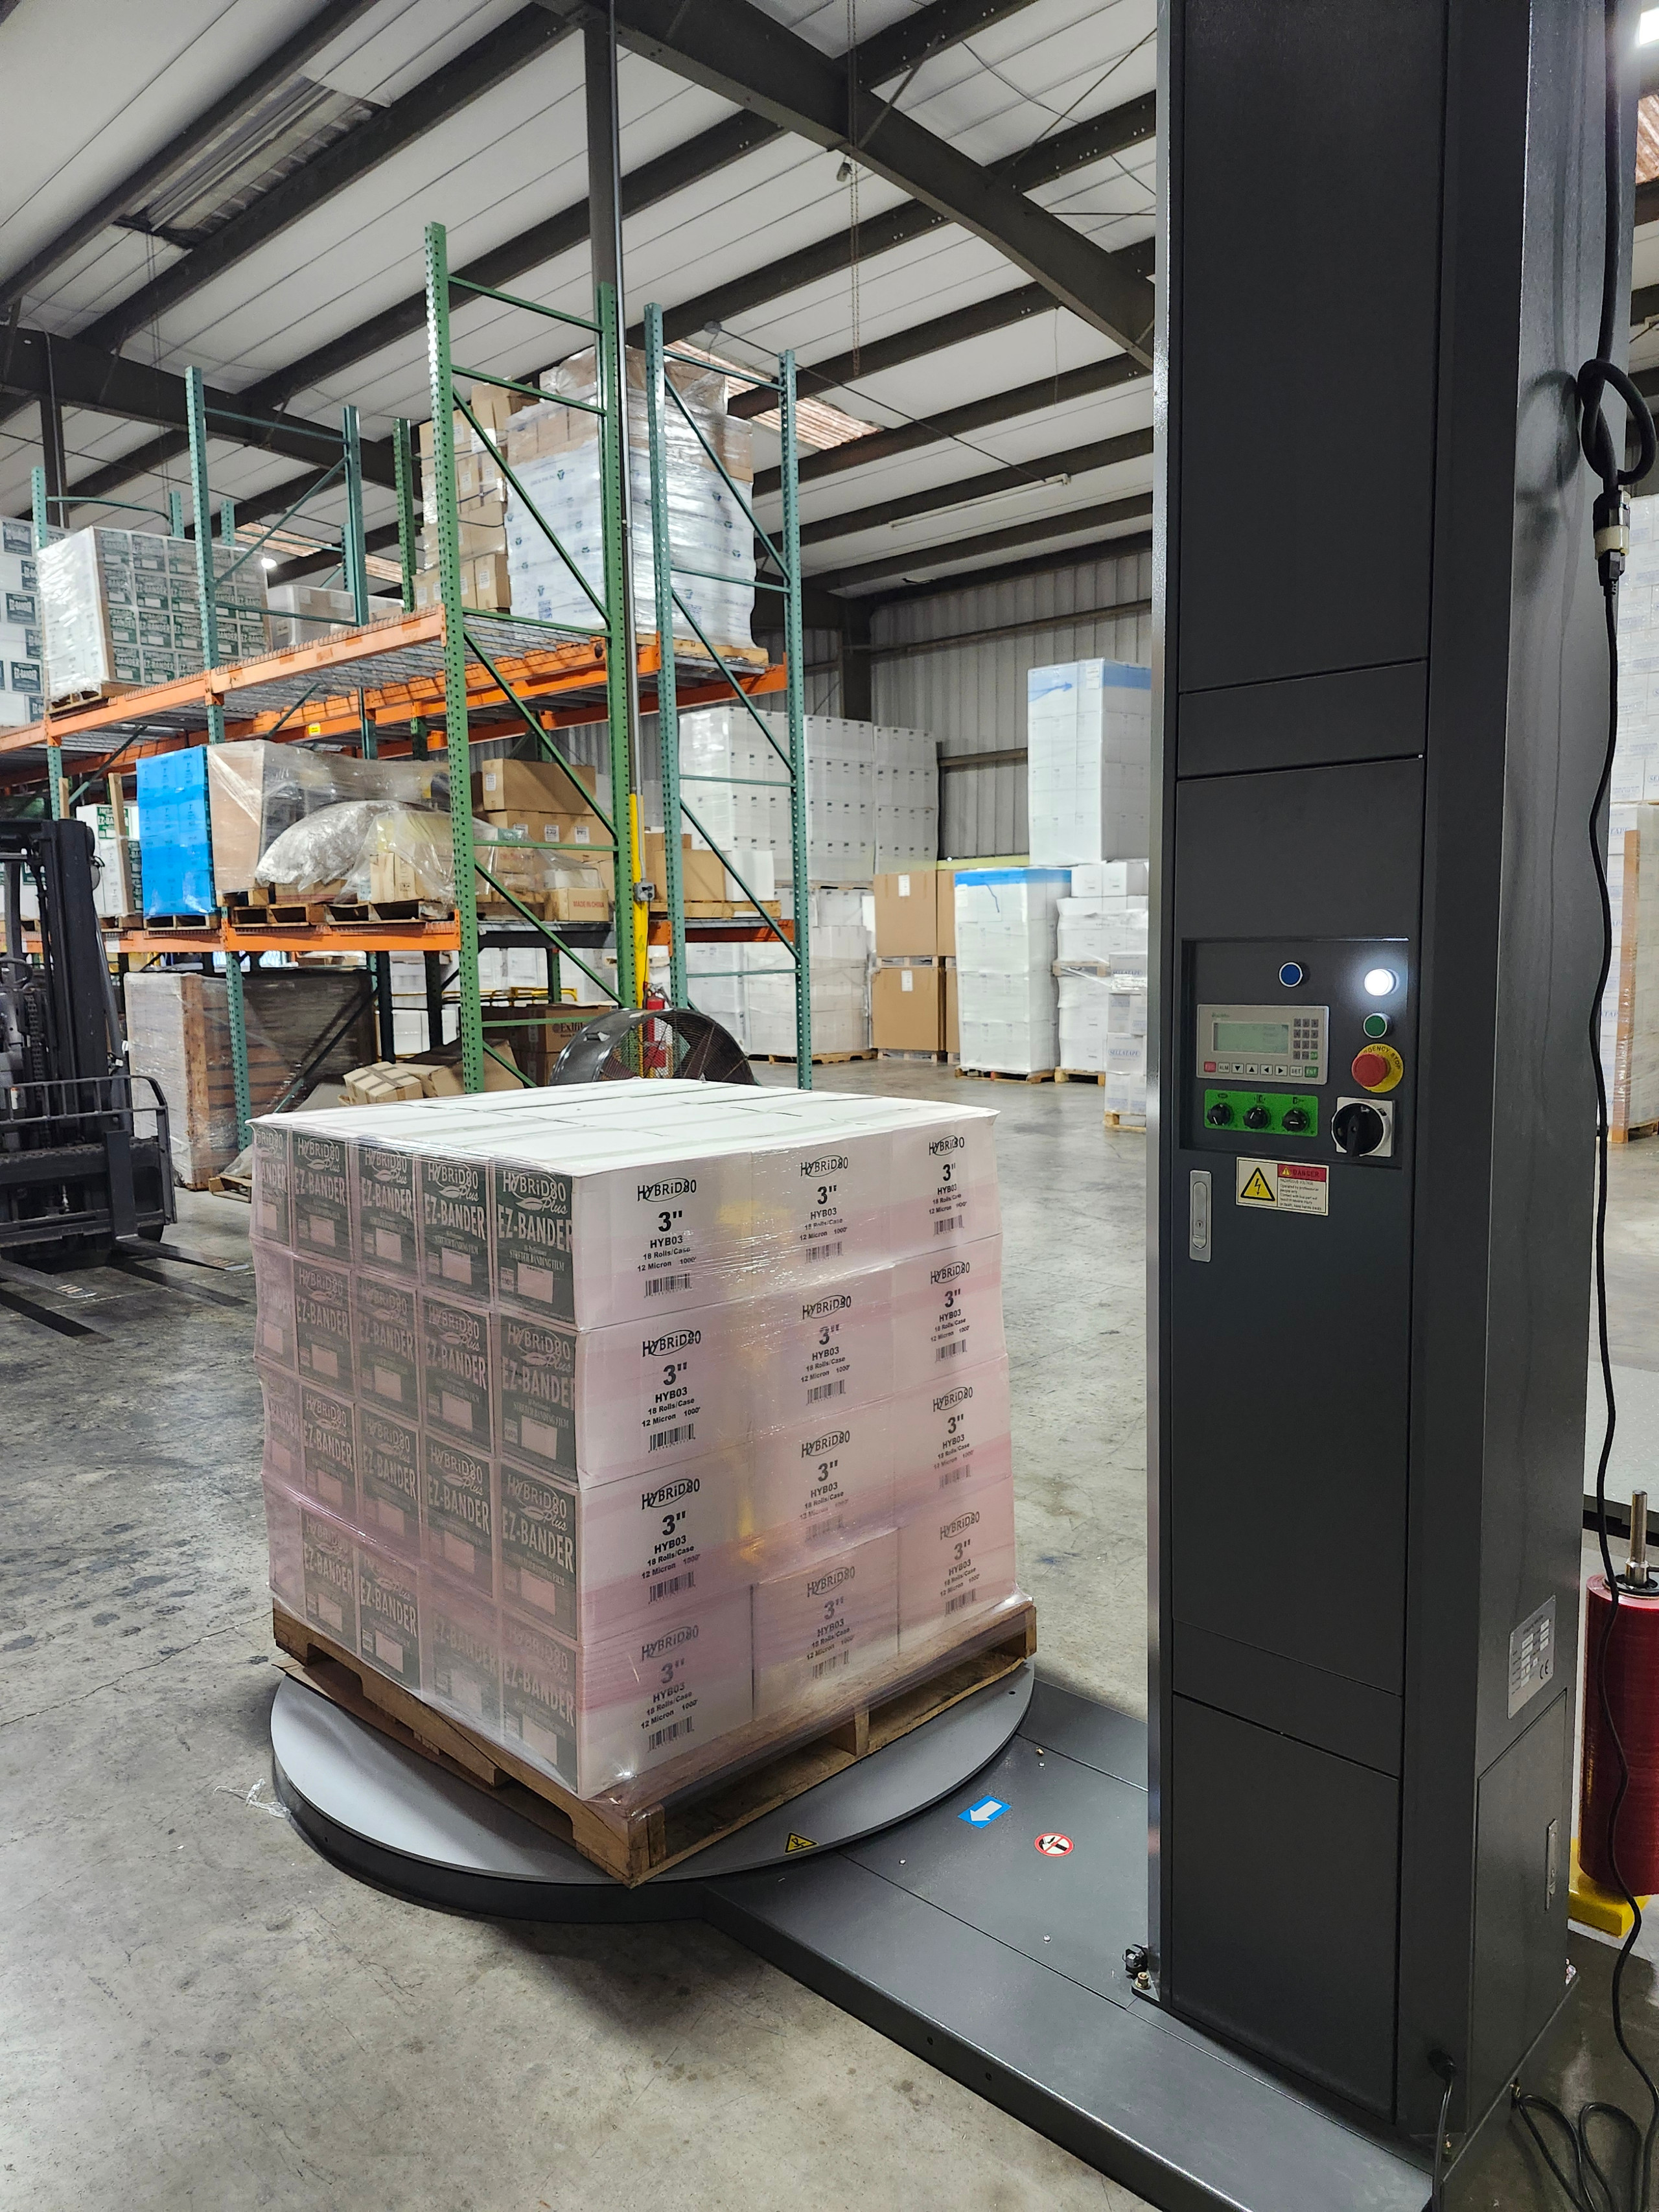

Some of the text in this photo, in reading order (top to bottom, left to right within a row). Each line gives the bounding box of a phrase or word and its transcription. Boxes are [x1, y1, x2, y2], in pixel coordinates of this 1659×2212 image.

[1391, 1053, 1401, 1070] STOP
[943, 1163, 956, 1181] 3"
[1293, 1169, 1319, 1178] DANGER
[294, 1167, 347, 1207] EZ-BANDER
[459, 1186, 480, 1202] Plus
[817, 1185, 837, 1205] 3"
[937, 1184, 957, 1195] HYB03
[360, 1177, 413, 1222] EZ-BANDER
[541, 1198, 568, 1215] Plus
[424, 1193, 486, 1240] EZ-BANDER
[658, 1210, 683, 1232] 3"
[810, 1207, 837, 1220] HYB03
[650, 1235, 683, 1248] HYB03
[654, 1248, 690, 1259] Rolls/Case
[648, 1261, 671, 1270] Micron
[944, 1288, 961, 1308] 3"
[939, 1309, 962, 1322] HYB03
[938, 1331, 954, 1340] Micron
[812, 1347, 839, 1361] HYB03
[815, 1356, 846, 1369] Rolls/Case
[663, 1362, 688, 1386] 3"
[810, 1370, 830, 1380] Micron
[655, 1387, 688, 1403] HYB03
[658, 1398, 695, 1412] Rolls/Case
[653, 1414, 676, 1425] Micron
[947, 1414, 964, 1434] 3"
[942, 1434, 965, 1449] HYB03
[817, 1460, 838, 1482] 3"
[462, 1476, 483, 1496] Plus
[810, 1482, 838, 1498] HYB03
[426, 1473, 490, 1535] EZ-BANDER
[813, 1491, 844, 1506] Rolls/Case
[544, 1511, 568, 1531] Plus
[662, 1511, 686, 1535] 3"
[502, 1506, 575, 1574] EZ-BANDER
[655, 1535, 686, 1554] HYB03
[658, 1546, 694, 1563] Rolls/Case
[954, 1539, 971, 1560] 3"
[652, 1563, 676, 1576] Micron
[948, 1559, 971, 1576] HYB03
[947, 1583, 964, 1594] Micron
[360, 1576, 417, 1638] EZ-BANDER
[817, 1619, 844, 1637] HYB03
[815, 1644, 835, 1655] Micron
[661, 1658, 685, 1684] 3"
[653, 1682, 685, 1703] HYB03
[647, 1692, 692, 1716] 18 Rolls/Case
[641, 1721, 649, 1729] 12
[651, 1710, 674, 1725] Micron
